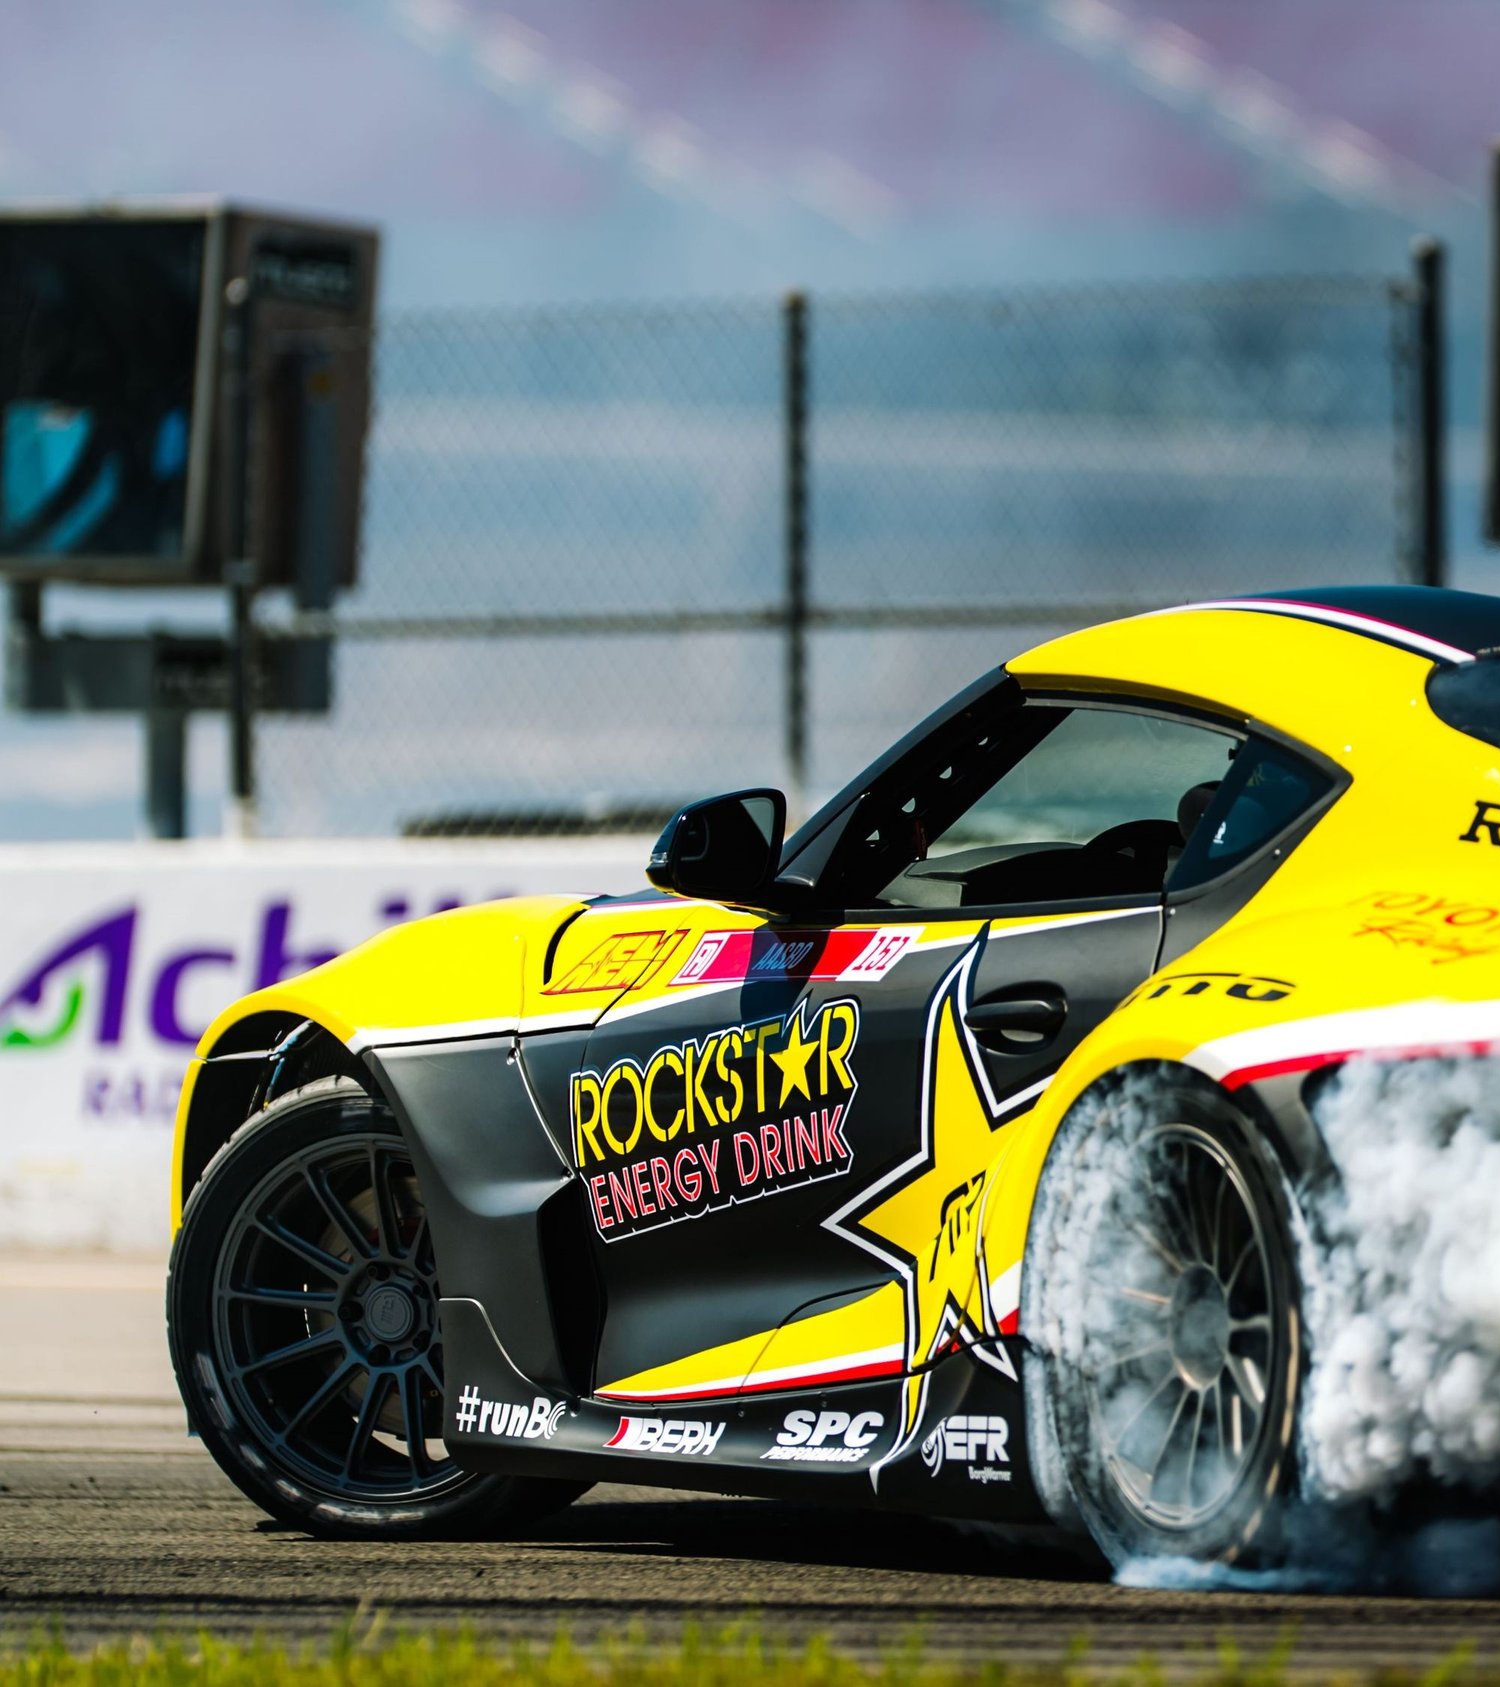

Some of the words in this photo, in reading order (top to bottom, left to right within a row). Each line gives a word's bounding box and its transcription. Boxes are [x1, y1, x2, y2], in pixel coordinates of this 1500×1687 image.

[852, 936, 911, 971] 151
[574, 1004, 854, 1168] ROCKSTAR
[590, 1138, 720, 1230] ENERGY
[733, 1104, 847, 1186] DRINK
[776, 1410, 884, 1448] SPC
[945, 1415, 1010, 1462] EFR
[760, 1446, 870, 1463] PERFORMANCE
